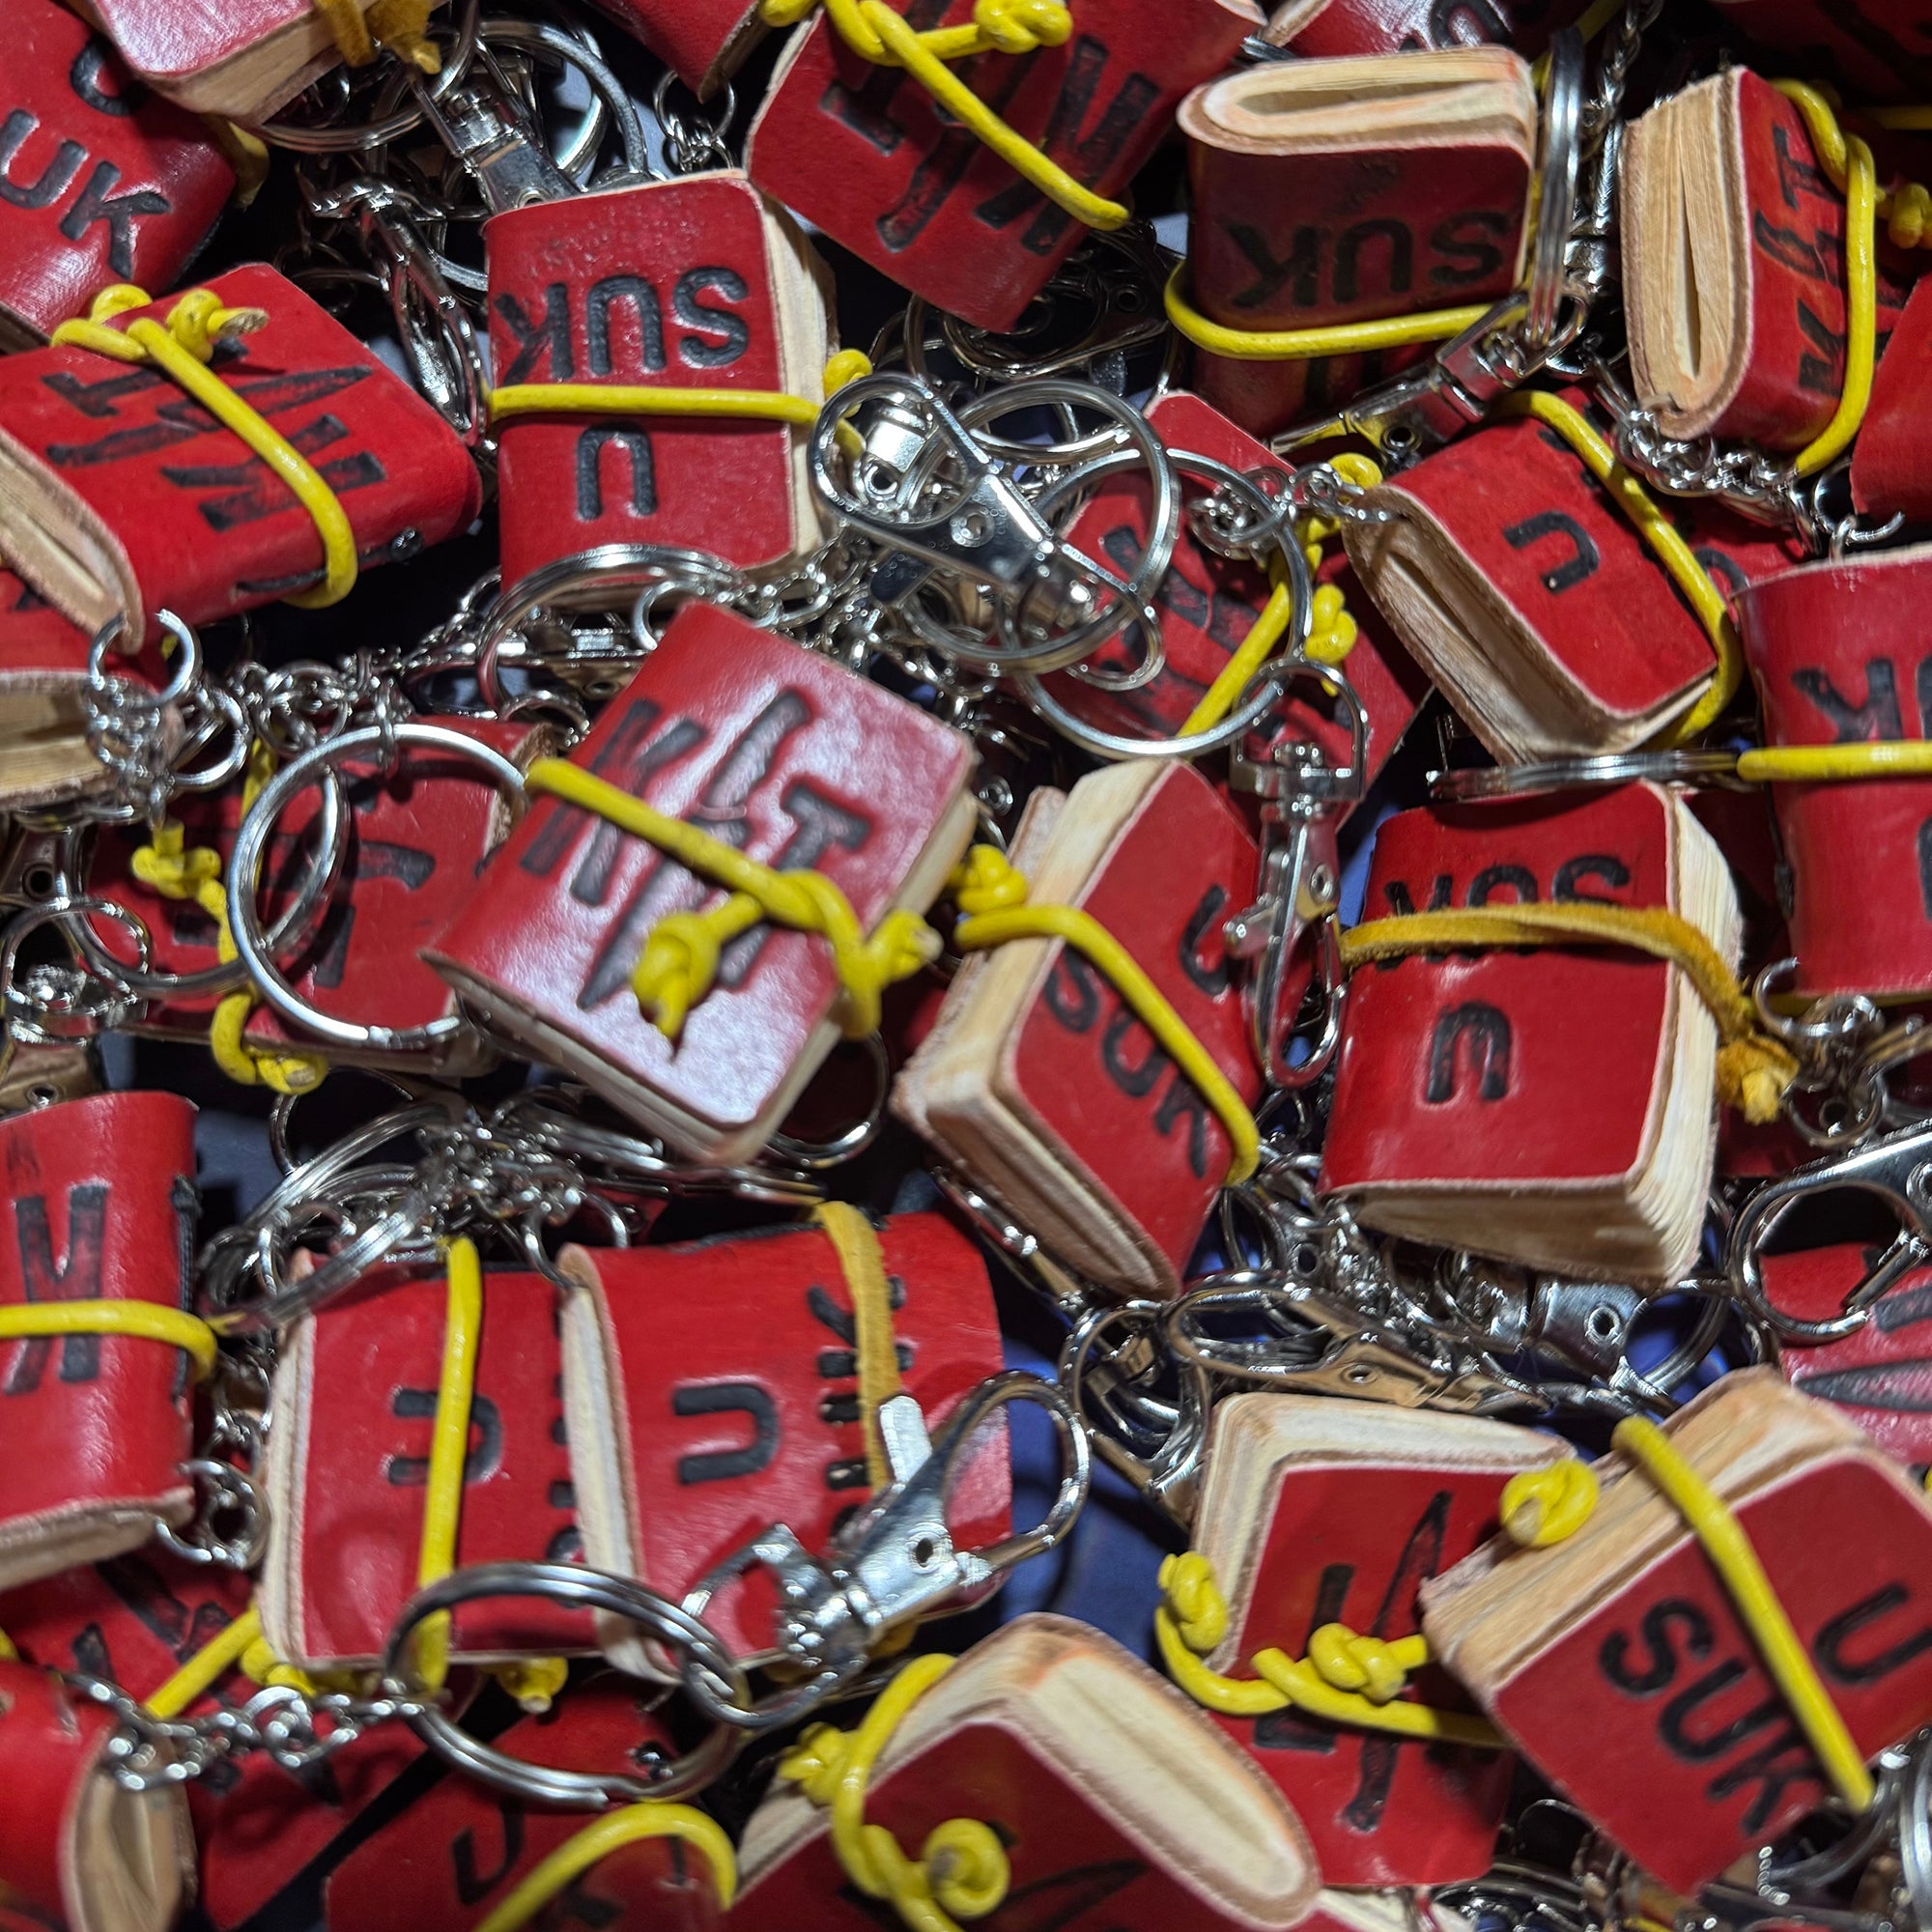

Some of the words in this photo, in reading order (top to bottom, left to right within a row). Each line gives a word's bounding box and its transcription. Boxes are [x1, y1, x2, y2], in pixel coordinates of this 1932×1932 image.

[1221, 209, 1513, 309] SUK
[495, 267, 752, 385] SUK
[576, 421, 658, 522] U
[1426, 1000, 1513, 1103] U
[672, 1381, 777, 1486] U
[1599, 1599, 1822, 1833] SUK
